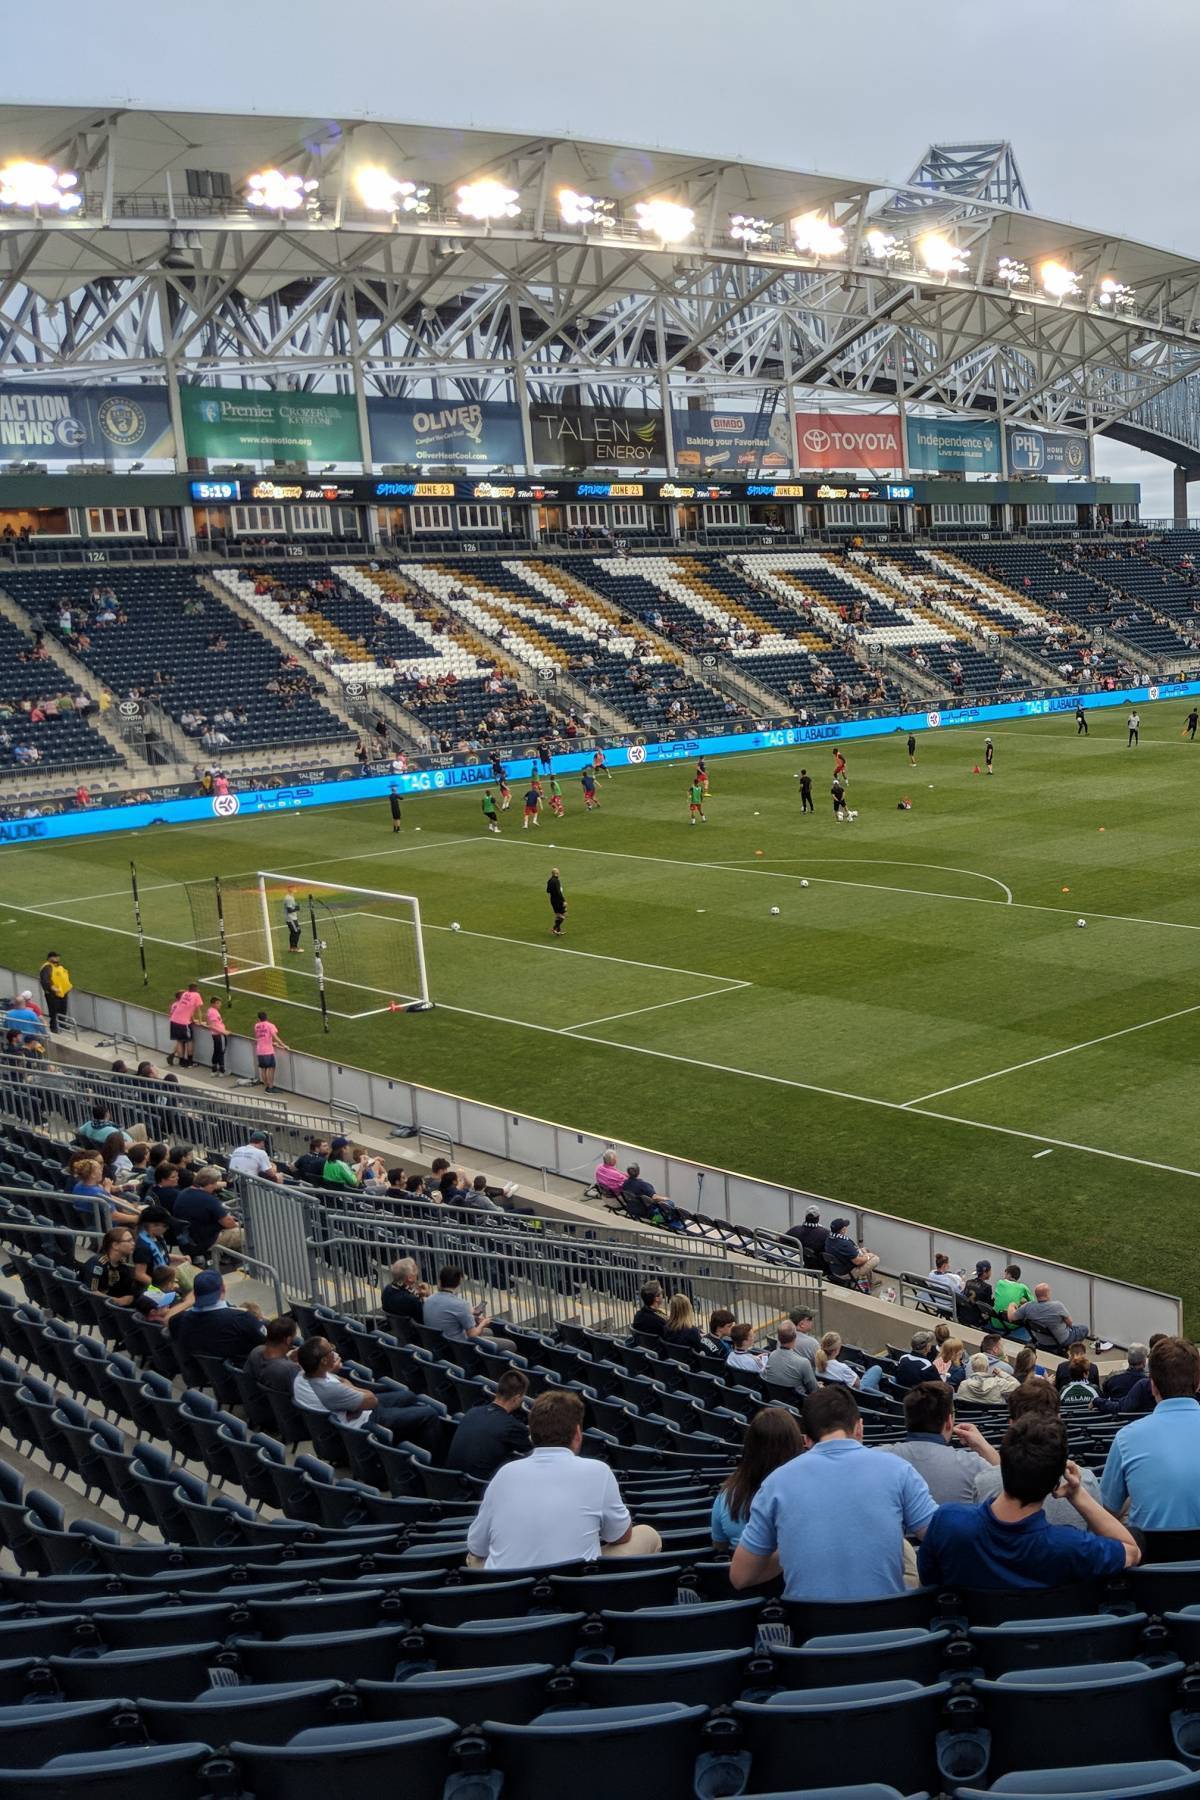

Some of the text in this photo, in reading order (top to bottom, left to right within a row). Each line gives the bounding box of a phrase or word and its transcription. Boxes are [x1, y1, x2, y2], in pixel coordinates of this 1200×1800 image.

[0, 395, 71, 421] ACTION
[221, 401, 275, 417] Premier
[412, 405, 482, 433] OLIVER
[713, 419, 743, 428] BIMBO
[1, 421, 55, 445] NEWS
[539, 415, 630, 442] TALEN
[686, 437, 714, 446] Baking
[831, 433, 897, 450] TOYOTA
[917, 434, 982, 448] Independence
[1015, 436, 1040, 452] PHL
[596, 445, 654, 460] ENERGY
[1028, 452, 1040, 467] 17
[200, 485, 232, 498] 5:19
[416, 484, 437, 495] JUNE
[440, 484, 451, 494] 23
[610, 485, 629, 495] JUNE
[631, 485, 640, 494] 23
[793, 487, 800, 496] 23
[892, 487, 910, 498] 5:19
[464, 544, 476, 552] 126
[614, 540, 626, 548] 127
[88, 552, 105, 562] 124
[288, 547, 303, 556] 125
[1025, 701, 1042, 714] TAG
[763, 731, 784, 747] TAG
